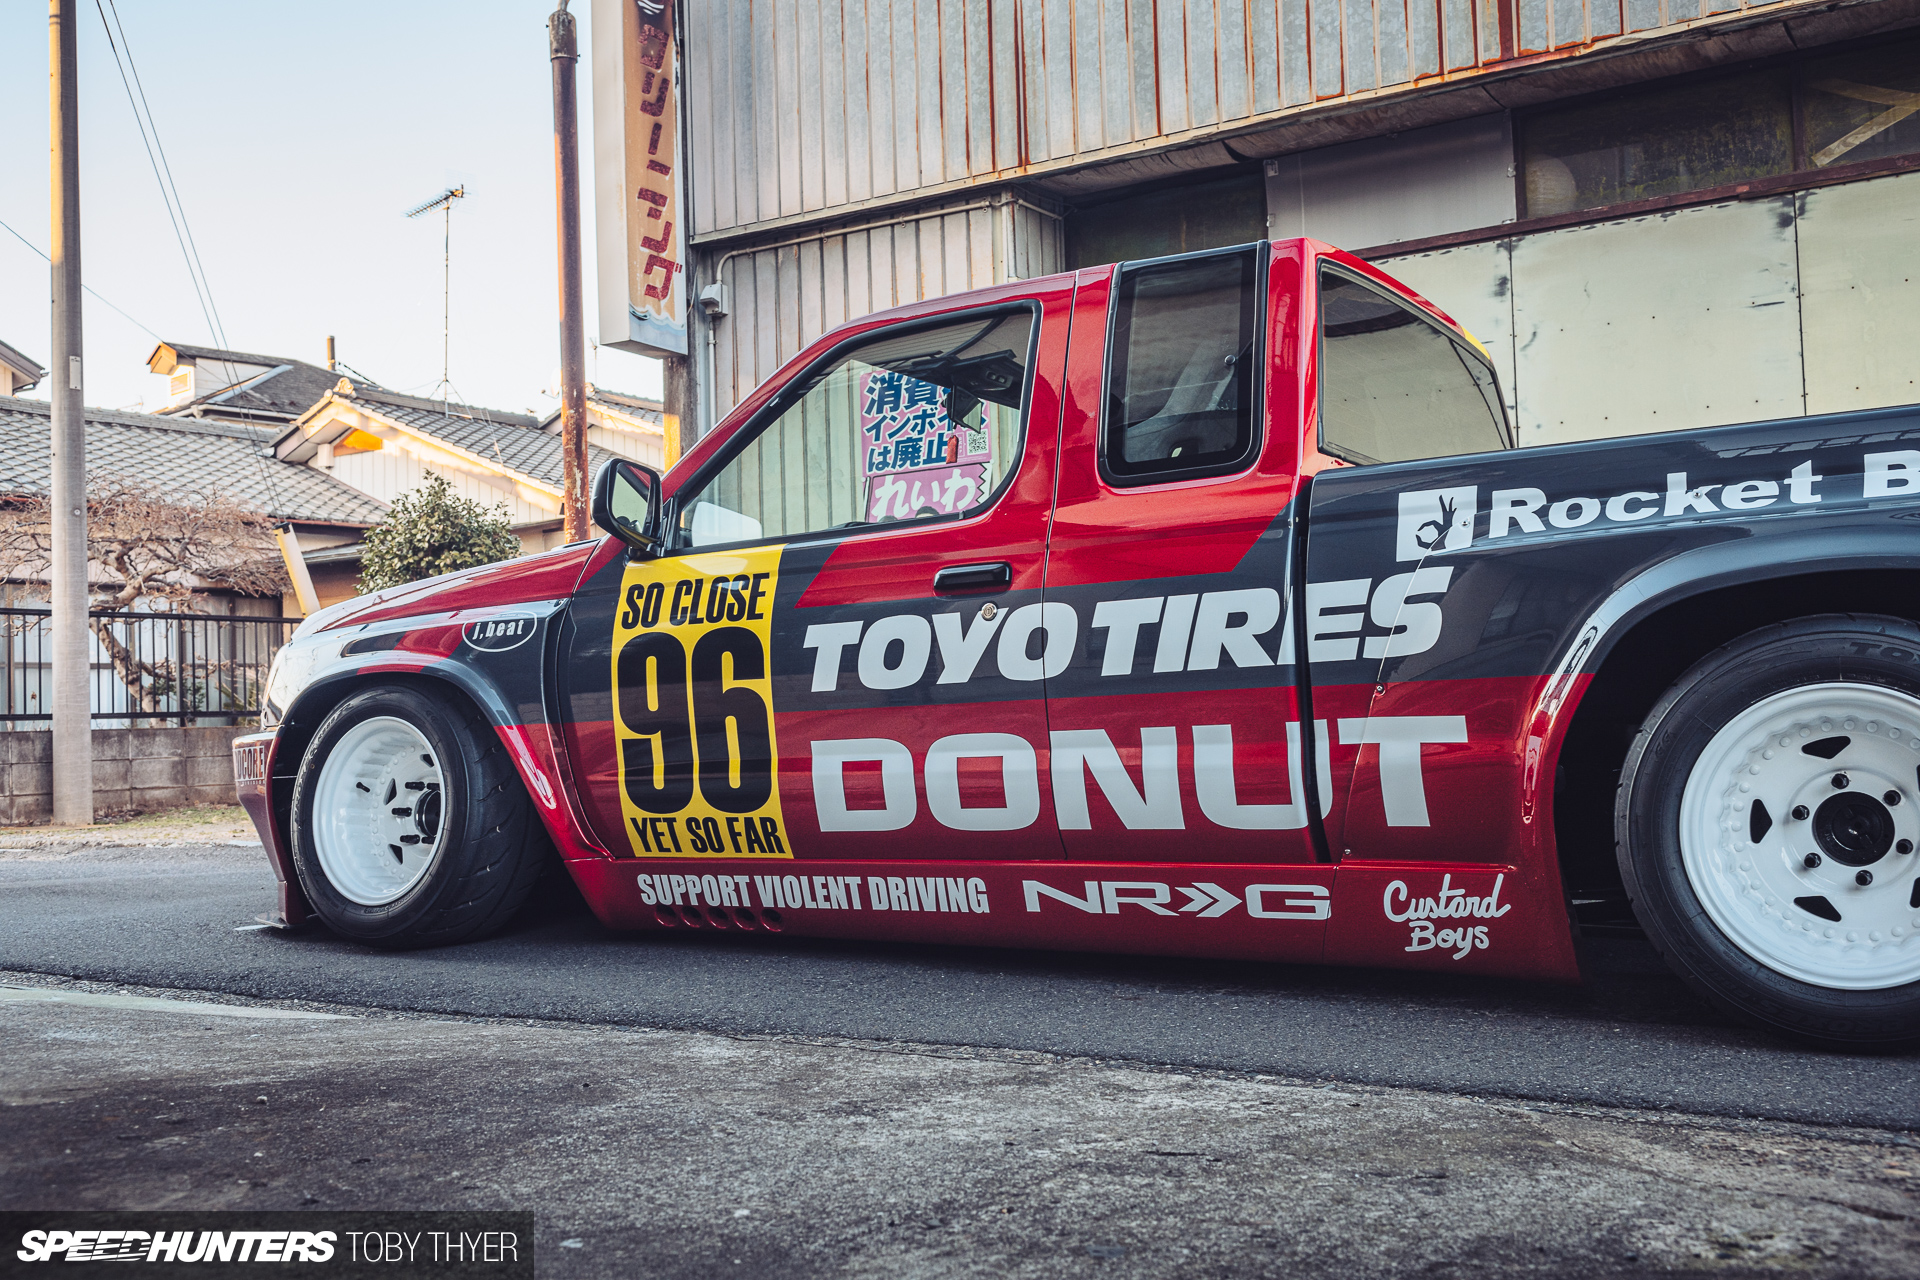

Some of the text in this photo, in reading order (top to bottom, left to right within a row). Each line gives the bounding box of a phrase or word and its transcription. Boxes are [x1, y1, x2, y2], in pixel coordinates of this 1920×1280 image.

[871, 469, 976, 522] れいわ
[1488, 459, 1823, 538] Rocket
[621, 573, 770, 629] SO CLOSE
[802, 566, 1454, 693] TOYO TIRES
[617, 626, 772, 814] 96
[810, 715, 1468, 832] DONUT
[630, 816, 785, 854] YET SO FAR
[636, 874, 990, 914] SUPPORT VIOLENT DRIVING
[1383, 873, 1511, 923] Custard
[1404, 921, 1489, 960] Boys
